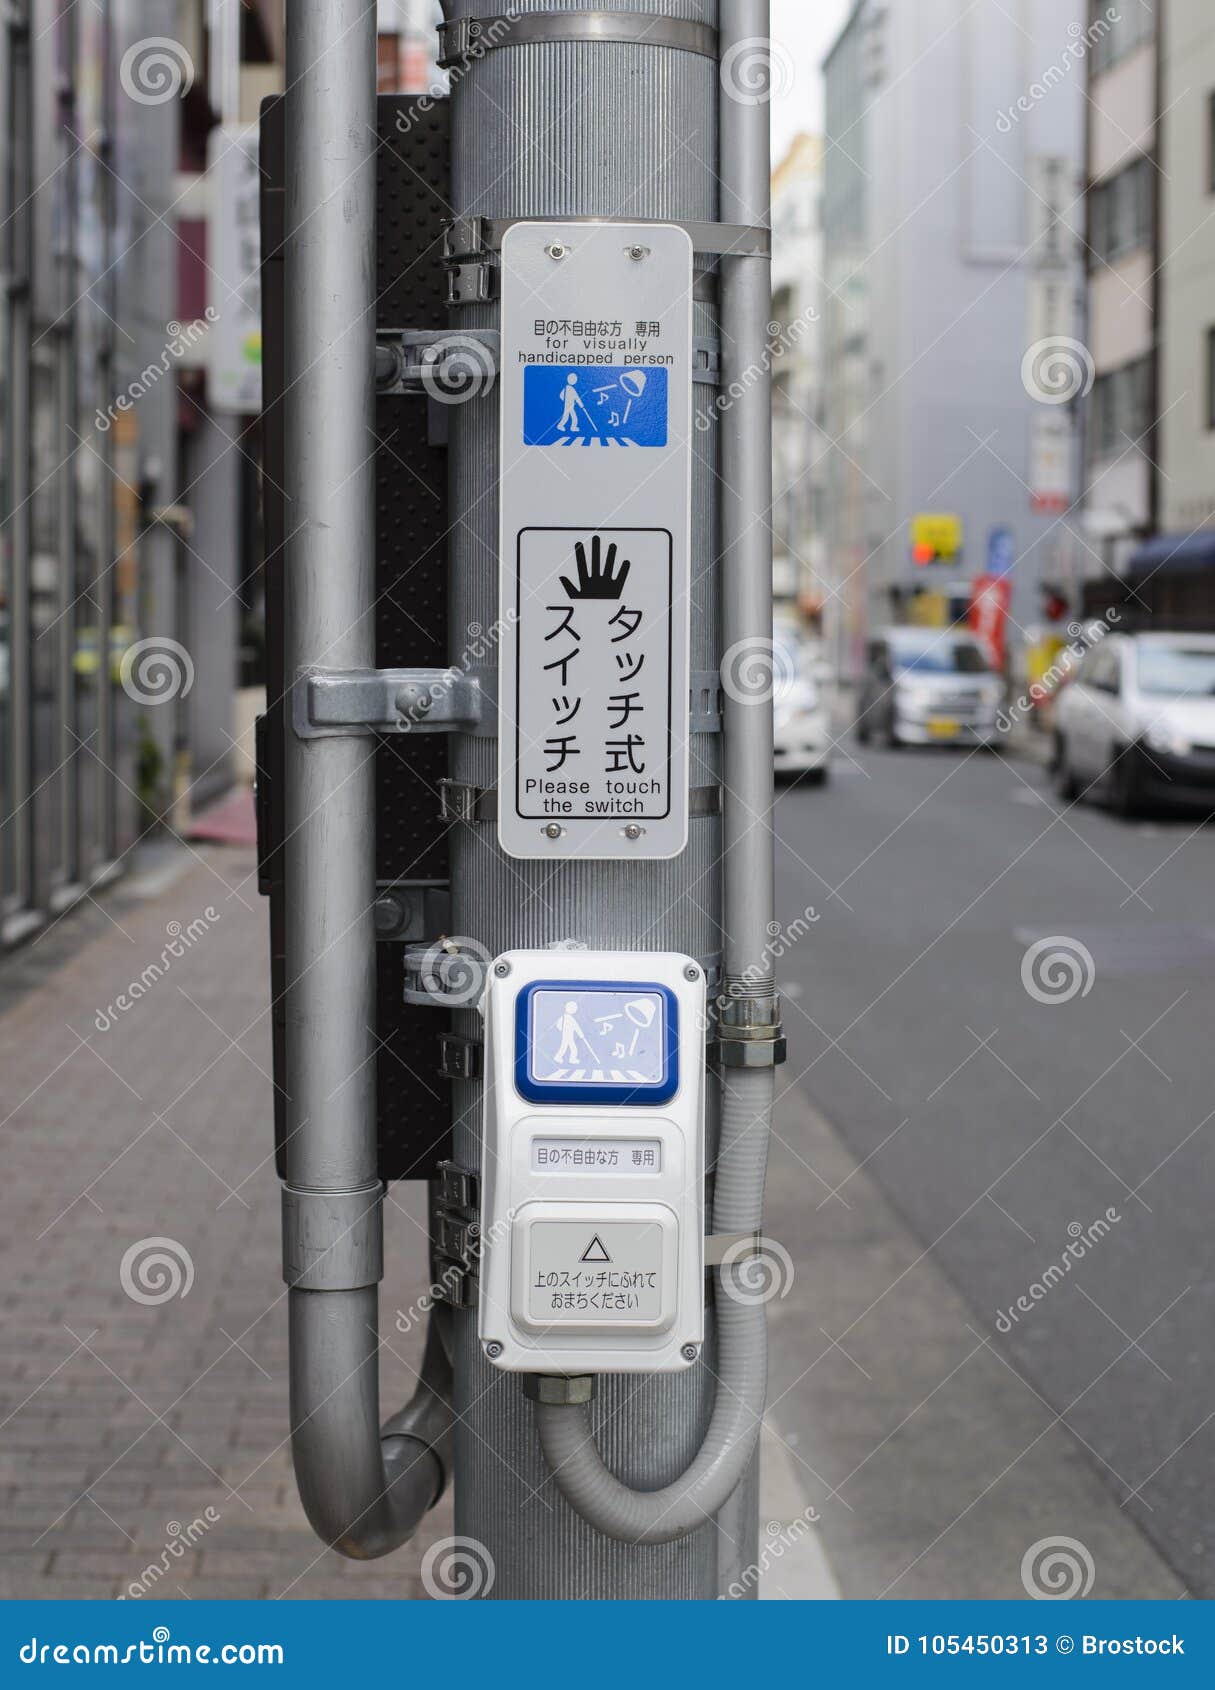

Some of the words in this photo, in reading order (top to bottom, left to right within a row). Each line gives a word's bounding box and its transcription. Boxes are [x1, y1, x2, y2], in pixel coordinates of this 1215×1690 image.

[534, 319, 622, 337] 目の不自由な方
[635, 321, 660, 337] 専用
[545, 337, 569, 348] for
[583, 337, 648, 351] visually
[518, 351, 613, 365] handicapped
[623, 353, 674, 365] person
[543, 605, 582, 773] スイッチ
[605, 604, 645, 774] タッチ式
[525, 778, 590, 794] Please
[606, 779, 661, 794] touch
[543, 798, 573, 813] the
[585, 798, 644, 813] switch
[537, 1148, 619, 1165] 目の不自由な方
[631, 1149, 655, 1166] 専用
[534, 1271, 657, 1288] 上のスイッチにふれて
[551, 1292, 639, 1309] おまちください
